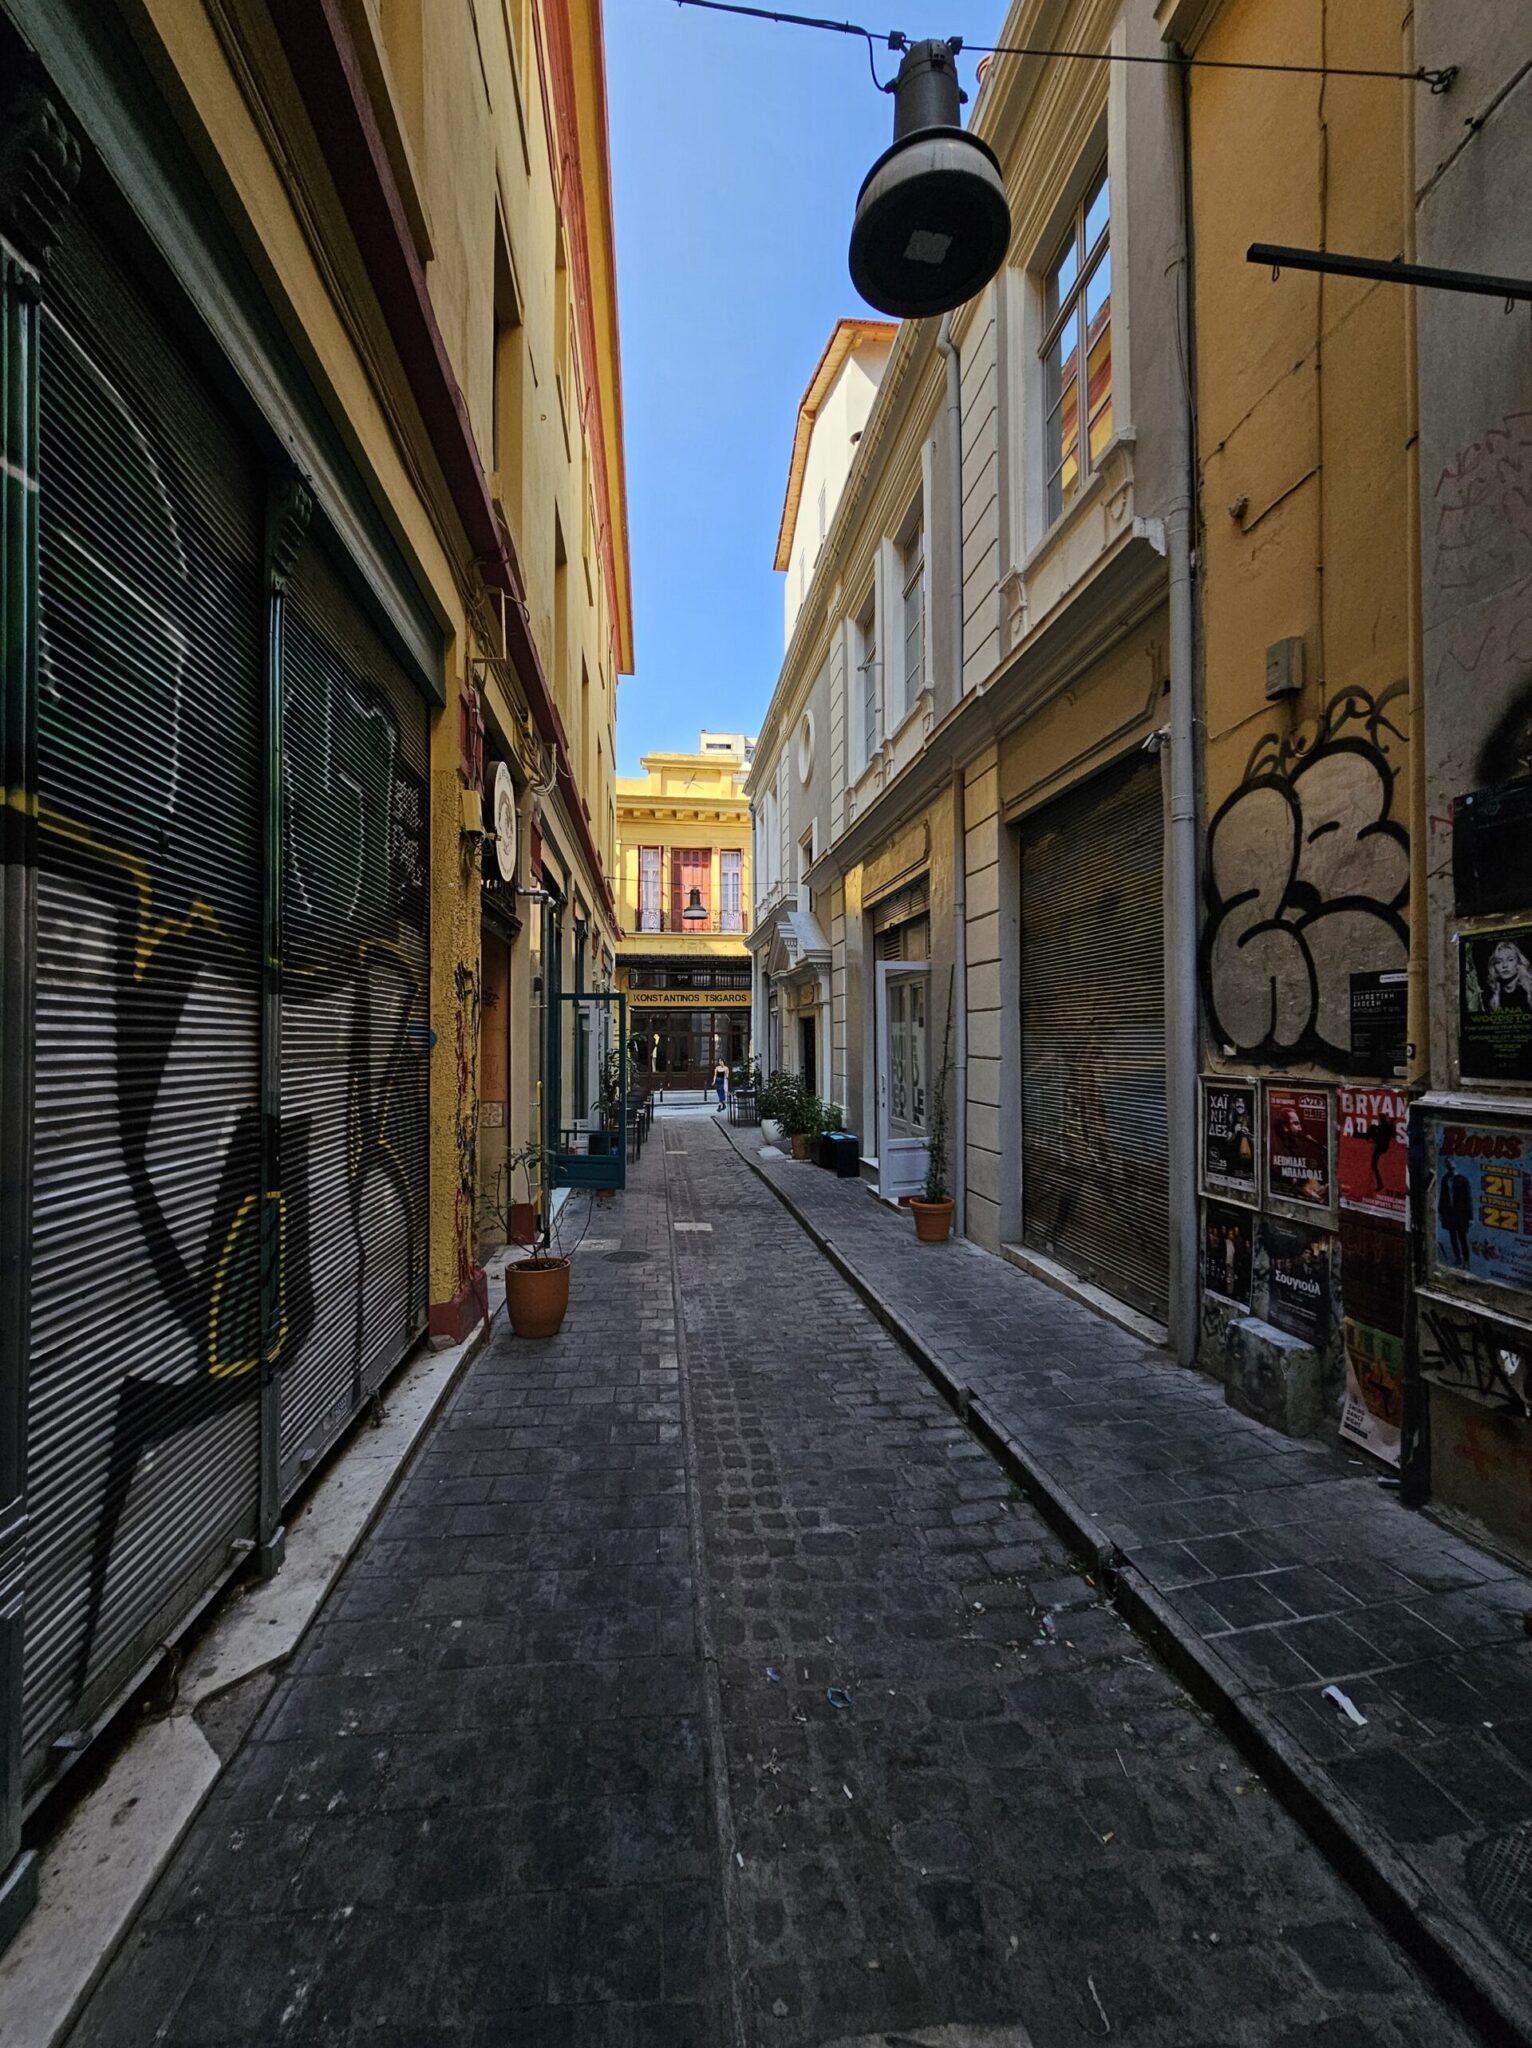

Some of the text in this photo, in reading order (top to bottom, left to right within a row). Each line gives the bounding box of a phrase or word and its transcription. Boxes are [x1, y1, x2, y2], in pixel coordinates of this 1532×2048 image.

[633, 993, 747, 1002] KONSTANTINOS TSIGAROS
[1471, 1013, 1532, 1023] WOODSTO
[1342, 1092, 1408, 1118] BRYAN
[1342, 1116, 1410, 1147] ADS
[1485, 1175, 1514, 1198] 21
[1483, 1207, 1518, 1232] 22
[1275, 1269, 1321, 1296] Σουγιούλ
